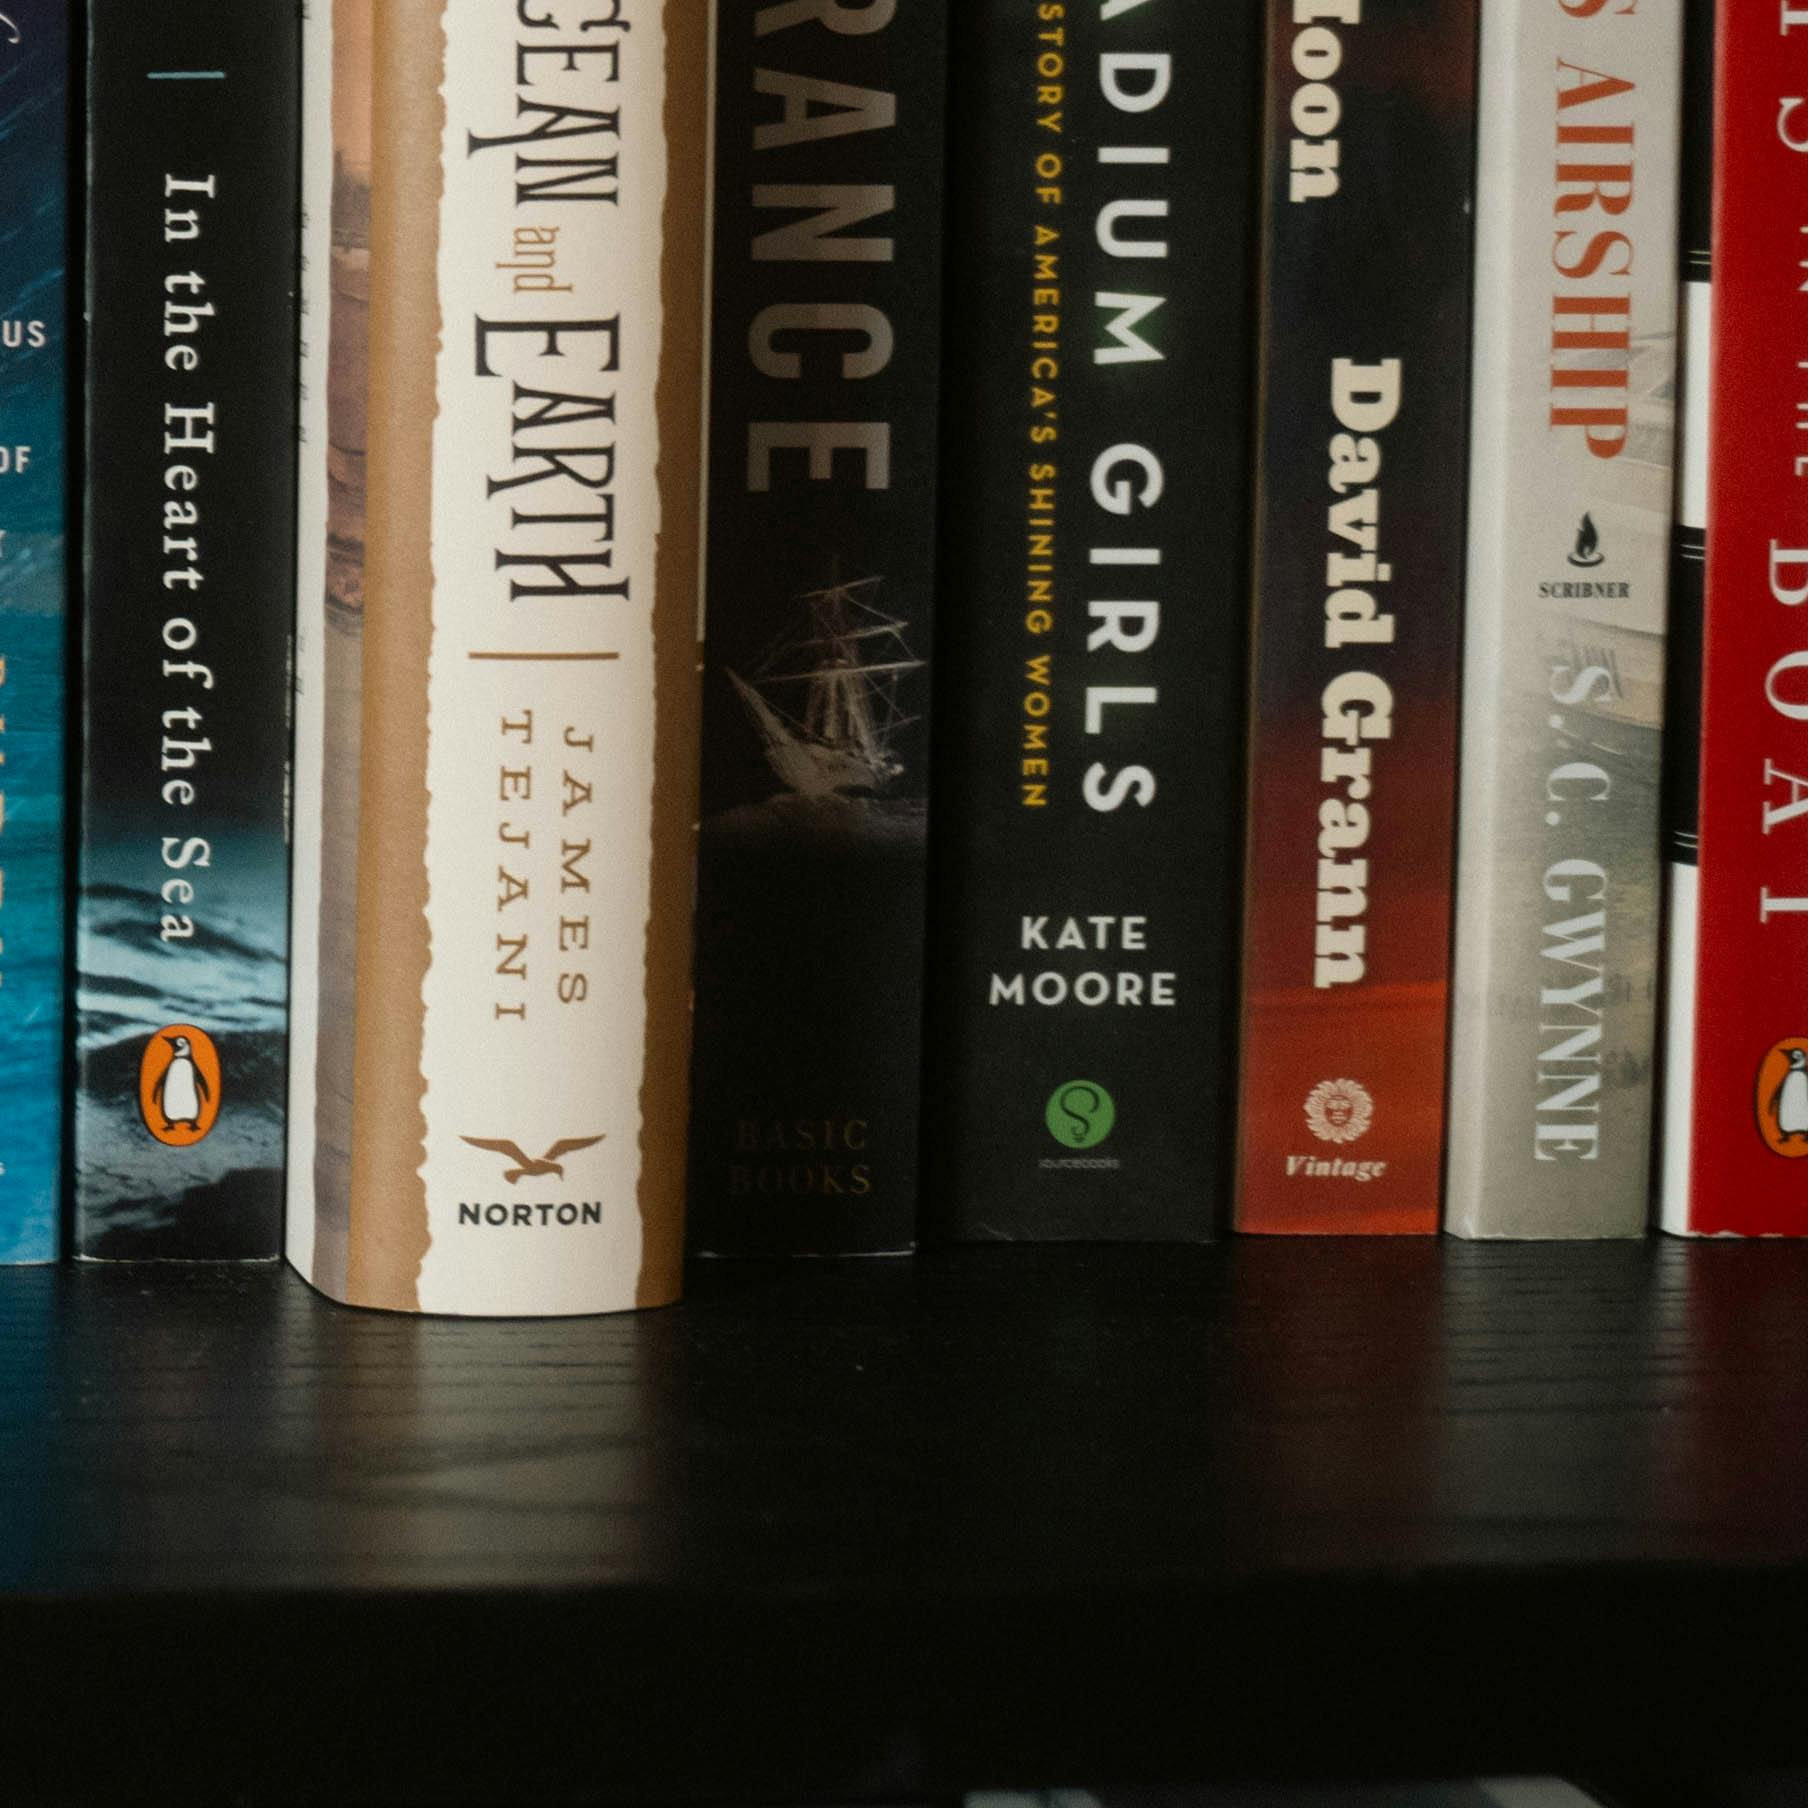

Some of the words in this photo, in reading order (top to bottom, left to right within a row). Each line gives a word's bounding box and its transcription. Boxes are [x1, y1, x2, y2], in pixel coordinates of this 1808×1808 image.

[1035, 0, 1066, 136] STORY
[162, 173, 216, 243] In
[1034, 152, 1063, 207] OF
[495, 225, 574, 296] and
[1549, 56, 1637, 461] AIRSHIP
[162, 270, 216, 373] the
[1029, 223, 1061, 446] AMERICA'S
[162, 401, 216, 594] Heart
[474, 313, 630, 603] EARTH
[1324, 356, 1404, 650] David
[1025, 461, 1057, 636] SHINING
[1537, 581, 1631, 599] SCRIBNER
[160, 616, 214, 692] of
[1082, 442, 1166, 814] GIRLS
[1020, 654, 1052, 810] WOMEN
[1548, 664, 1611, 730] S.
[160, 704, 213, 807] the
[1544, 761, 1612, 827] C.
[494, 709, 533, 1022] TEJANI
[557, 725, 594, 1005] JAMES
[1313, 668, 1397, 990] Grann
[159, 835, 212, 944] Sea
[1020, 914, 1148, 951] KATE
[988, 970, 1177, 1007] MOORE
[1533, 857, 1608, 1163] GWYNNE
[458, 1202, 603, 1226] NORTON
[1283, 1154, 1388, 1183] Vintage
